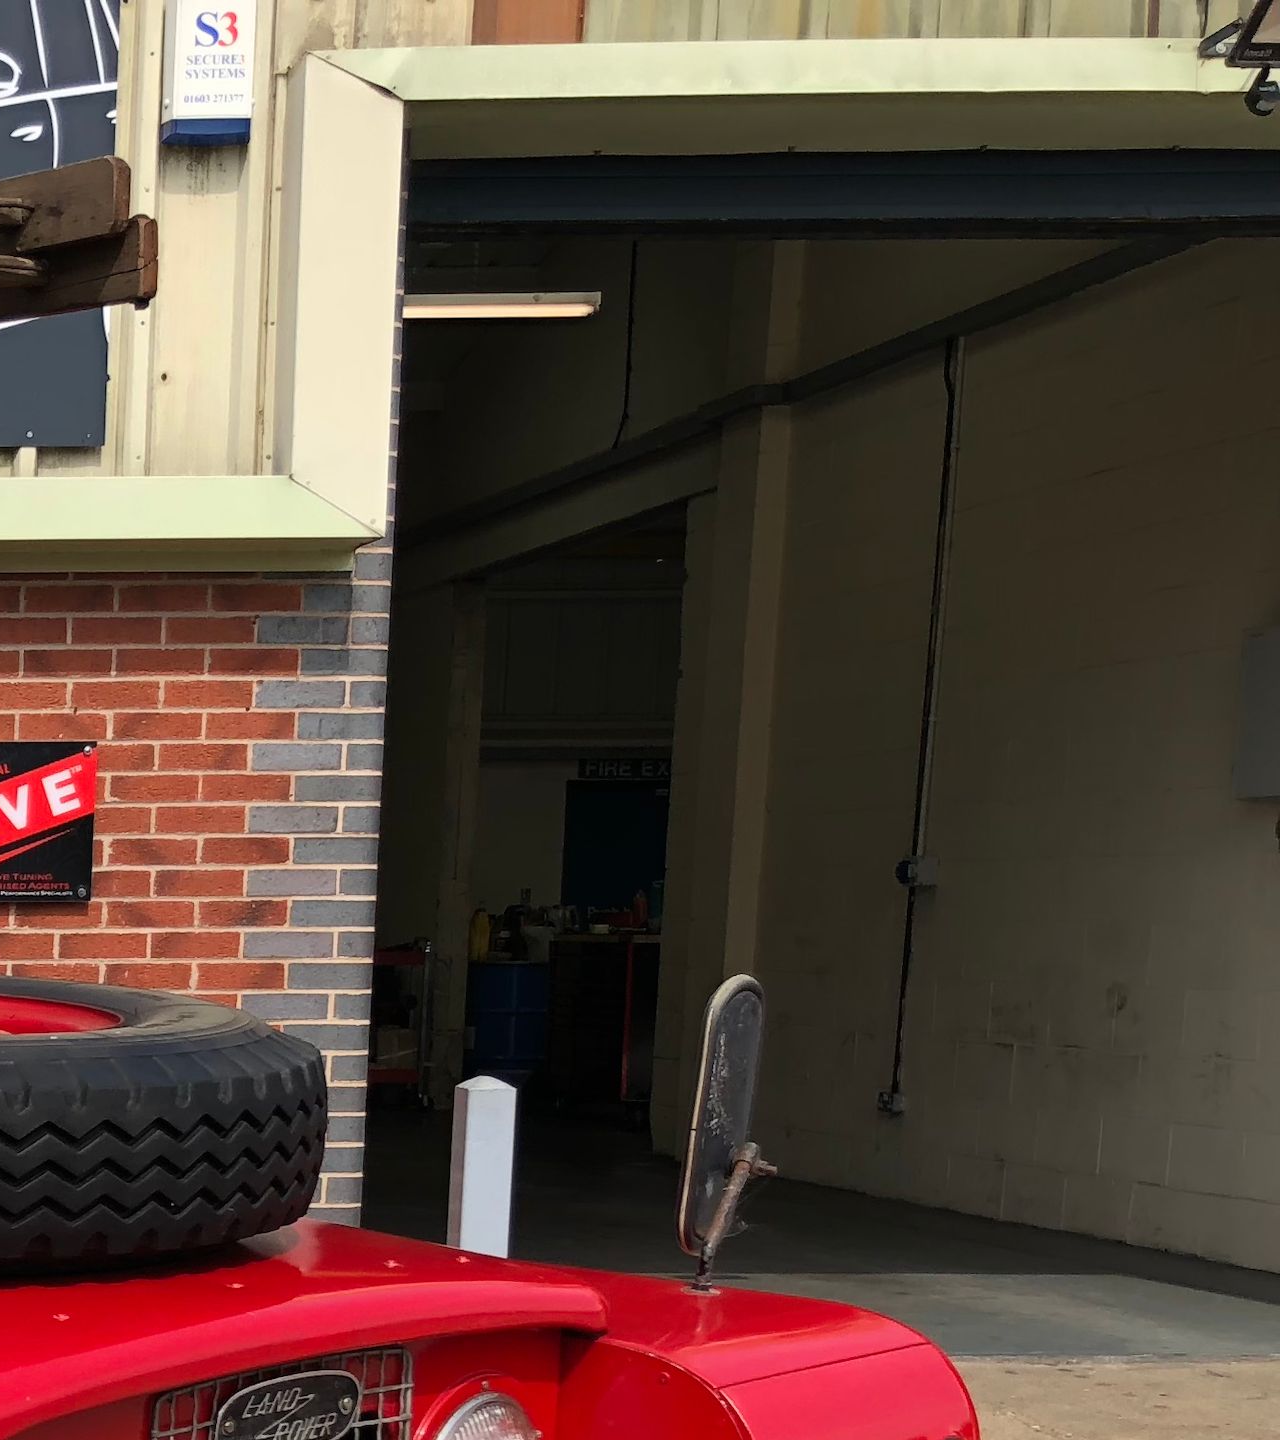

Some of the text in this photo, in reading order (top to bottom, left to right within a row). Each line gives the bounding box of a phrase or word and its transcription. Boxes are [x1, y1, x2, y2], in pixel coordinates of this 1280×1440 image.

[195, 11, 239, 47] S3
[186, 54, 245, 66] SECURE3
[185, 68, 246, 80] SYSTEMS
[183, 94, 244, 104] 01603 271377
[585, 760, 670, 777] FIRE EX
[12, 873, 54, 881] TUNING
[28, 882, 70, 890] AGENTS
[241, 1387, 302, 1419] LAND
